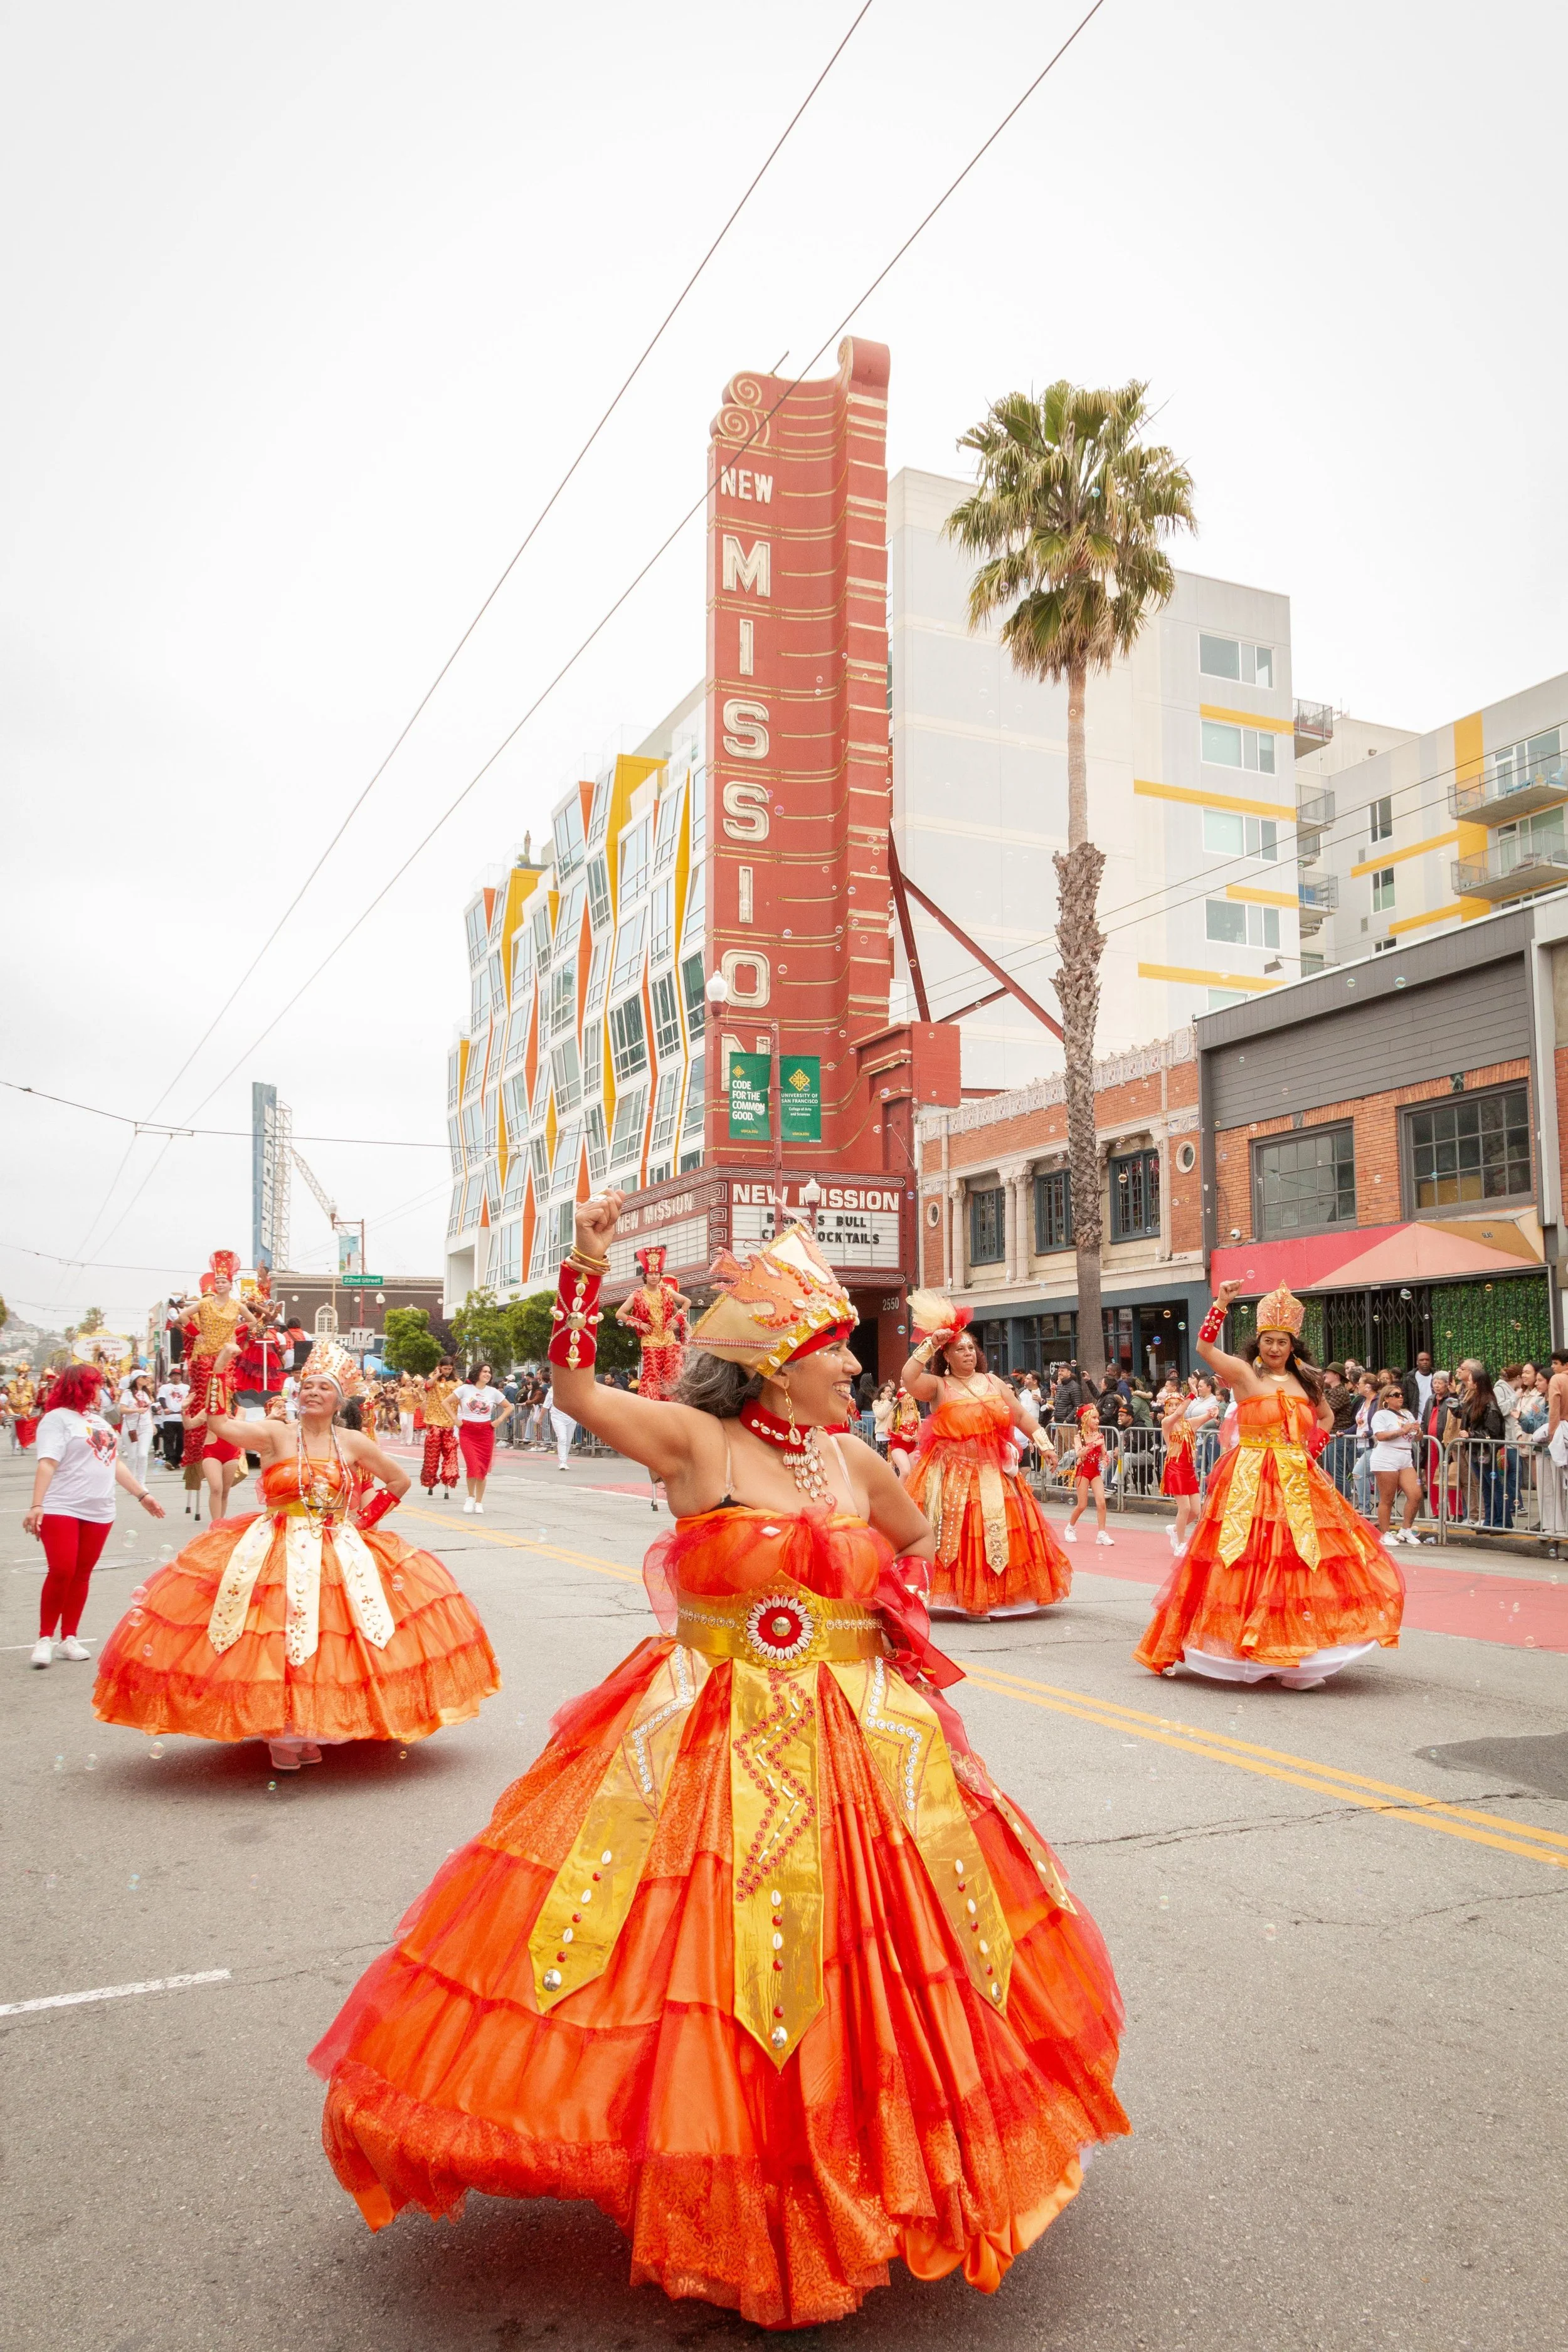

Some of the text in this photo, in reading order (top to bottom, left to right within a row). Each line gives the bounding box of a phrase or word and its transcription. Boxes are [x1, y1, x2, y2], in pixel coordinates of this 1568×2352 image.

[721, 465, 773, 504] NEW
[732, 1080, 751, 1090] CODE
[732, 1090, 760, 1101] FOR THE
[732, 1101, 765, 1111] COMMON
[732, 1111, 754, 1121] GOOD.
[733, 1184, 788, 1205] NEW
[616, 1192, 692, 1234] NEW MISSION
[836, 1216, 866, 1227] BULL
[817, 1231, 880, 1244] OCKTAILS
[882, 1296, 899, 1311] 2550
